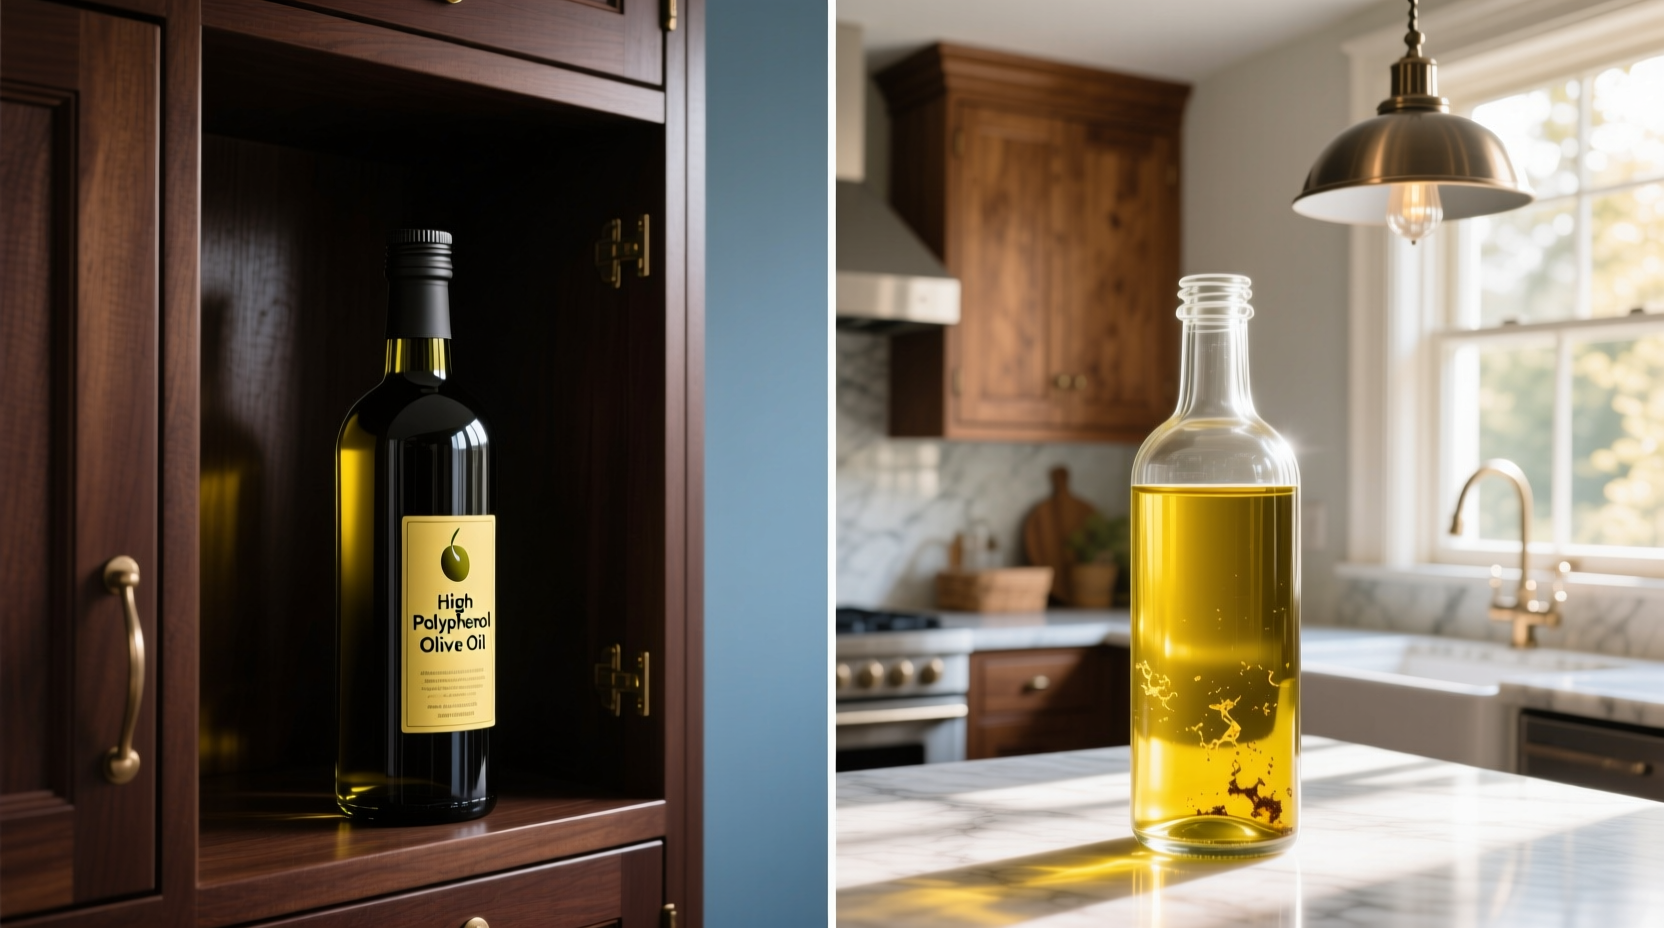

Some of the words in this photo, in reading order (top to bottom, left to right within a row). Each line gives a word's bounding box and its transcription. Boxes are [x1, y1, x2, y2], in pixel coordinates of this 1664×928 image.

[438, 592, 473, 613] High
[420, 636, 463, 653] Olive
[466, 634, 486, 651] Oil
